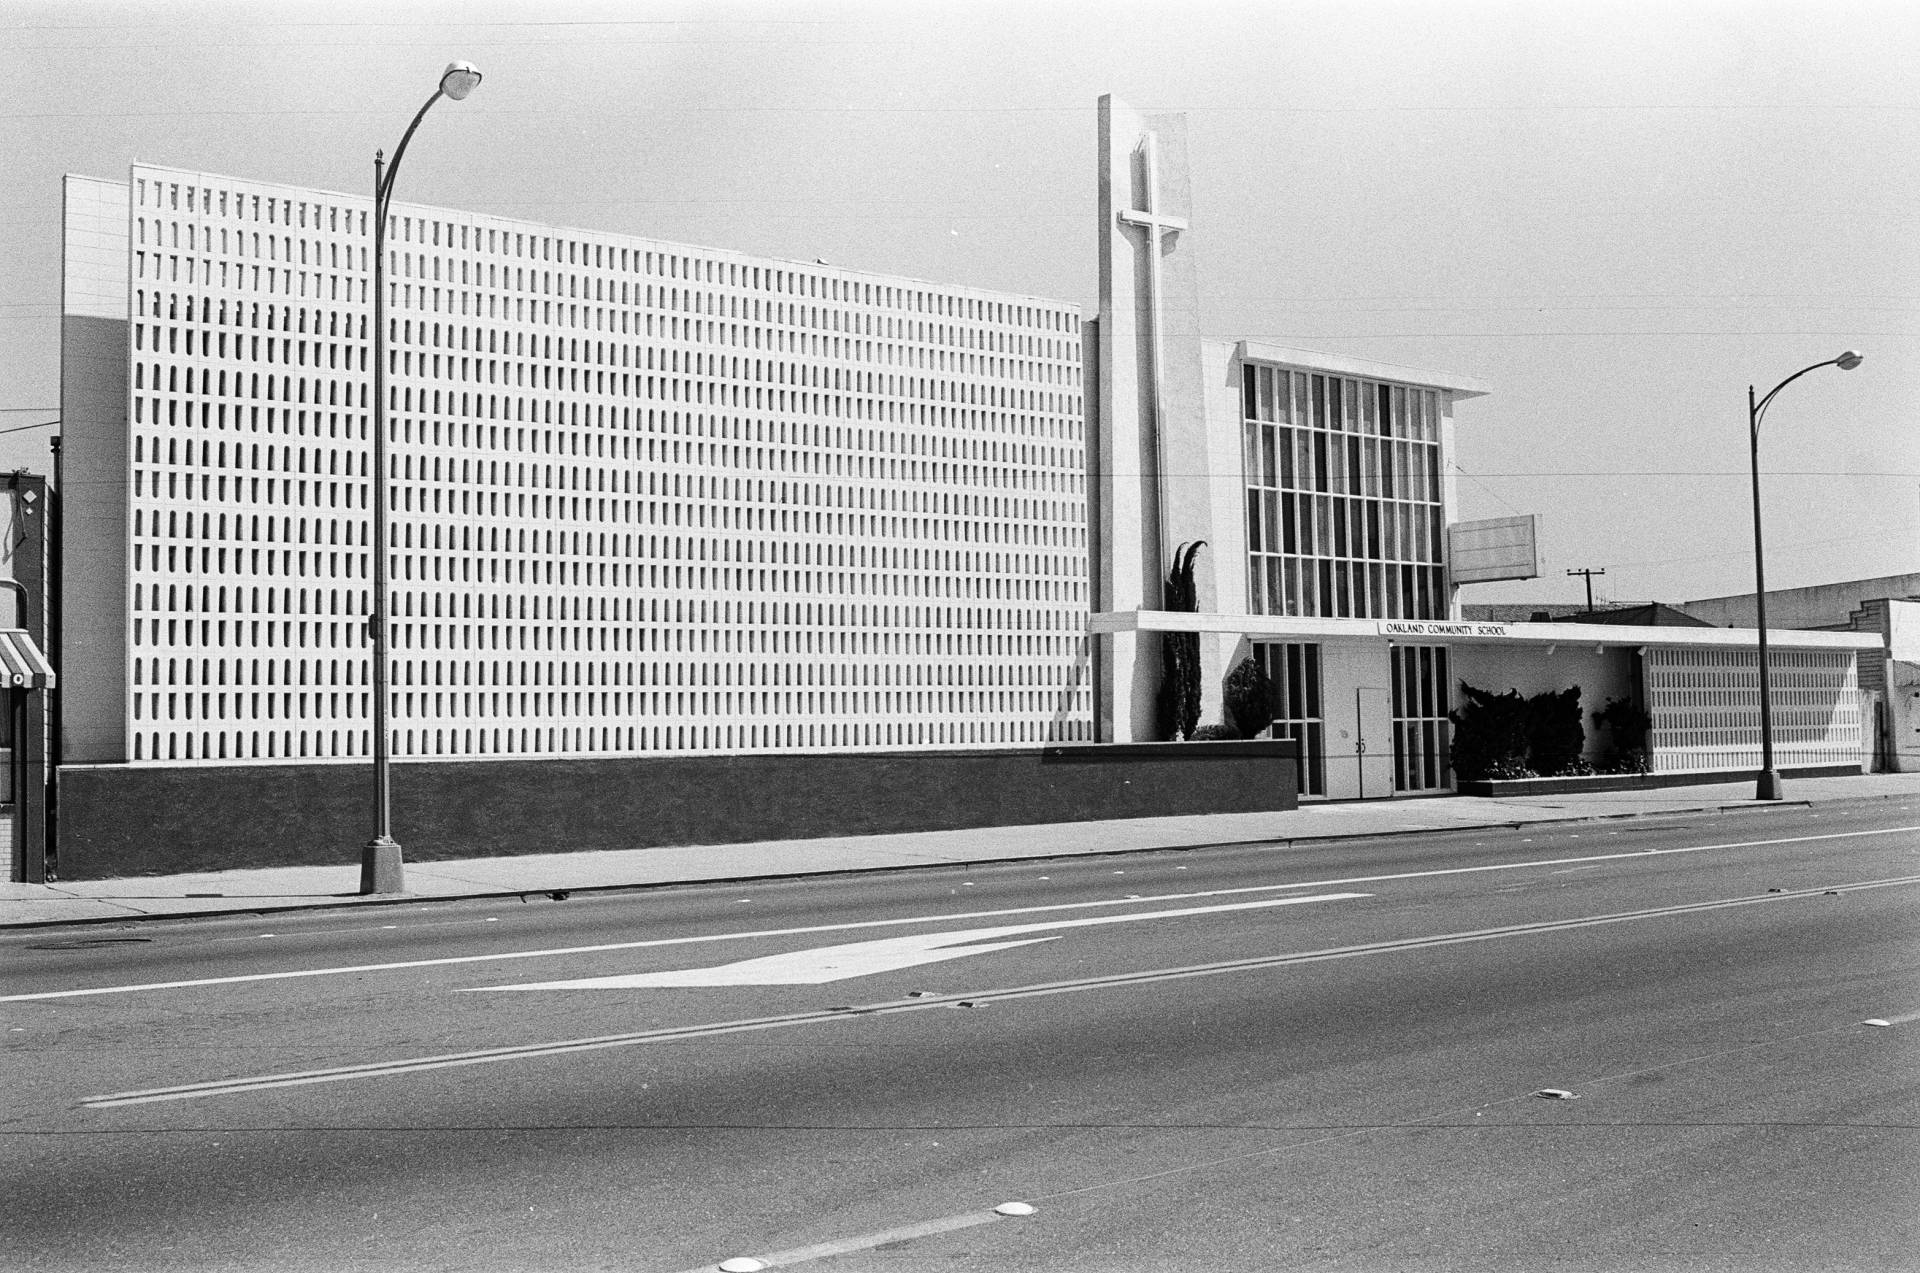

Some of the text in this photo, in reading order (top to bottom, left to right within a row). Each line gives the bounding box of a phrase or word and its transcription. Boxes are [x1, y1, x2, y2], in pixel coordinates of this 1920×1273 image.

[1386, 623, 1506, 635] OAKLAND COMMUNITY SCHOOL
